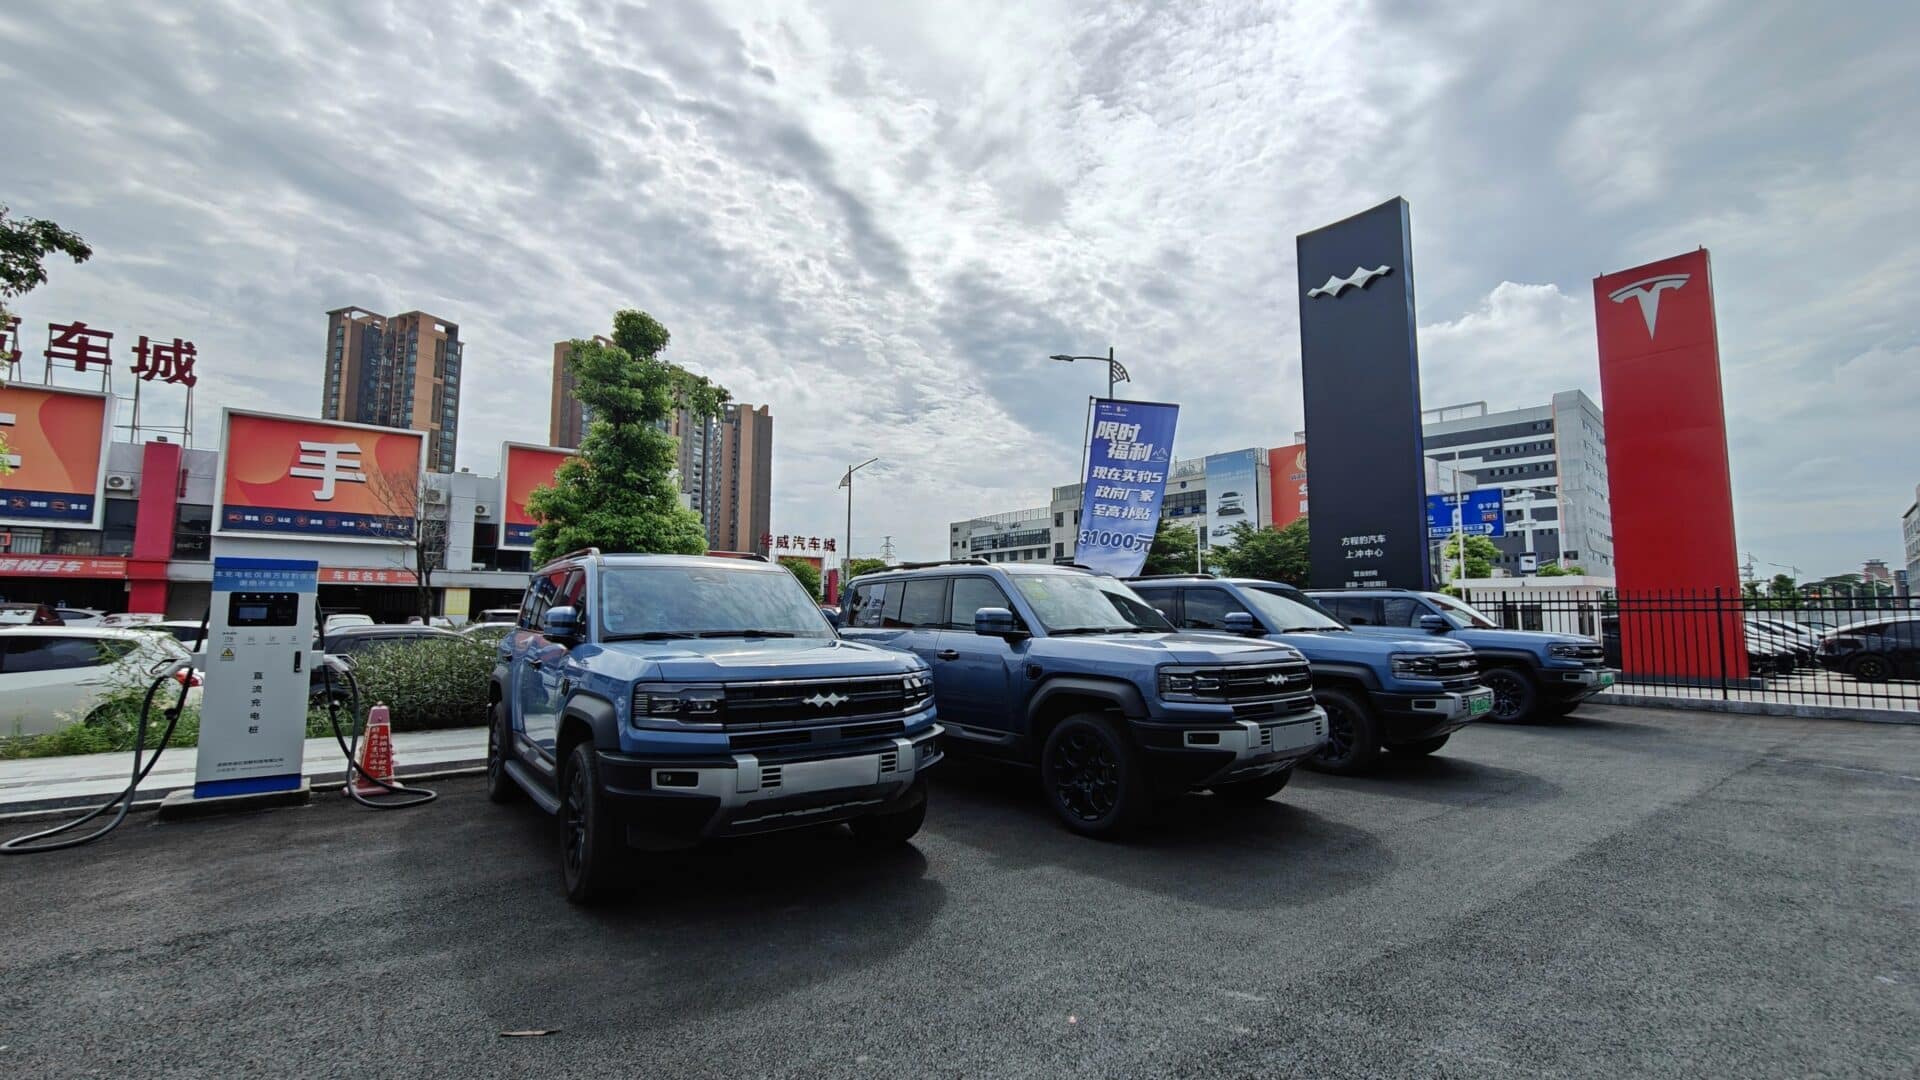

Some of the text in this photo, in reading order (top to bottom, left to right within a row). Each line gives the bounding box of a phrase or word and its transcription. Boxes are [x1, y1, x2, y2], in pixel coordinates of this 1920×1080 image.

[1095, 421, 1141, 443] 限时
[1107, 441, 1153, 461] 福利
[290, 441, 367, 500] 手
[1092, 466, 1163, 483] 现在买豹5
[1094, 485, 1155, 502] 政府厂家
[1092, 504, 1151, 520] 至高补贴
[760, 533, 836, 553] 华威汽车城
[1079, 529, 1154, 552] 31000元
[1341, 535, 1387, 546] 方程豹汽车
[1345, 549, 1384, 559] 上冲中心
[248, 671, 264, 734] 直流充电桩
